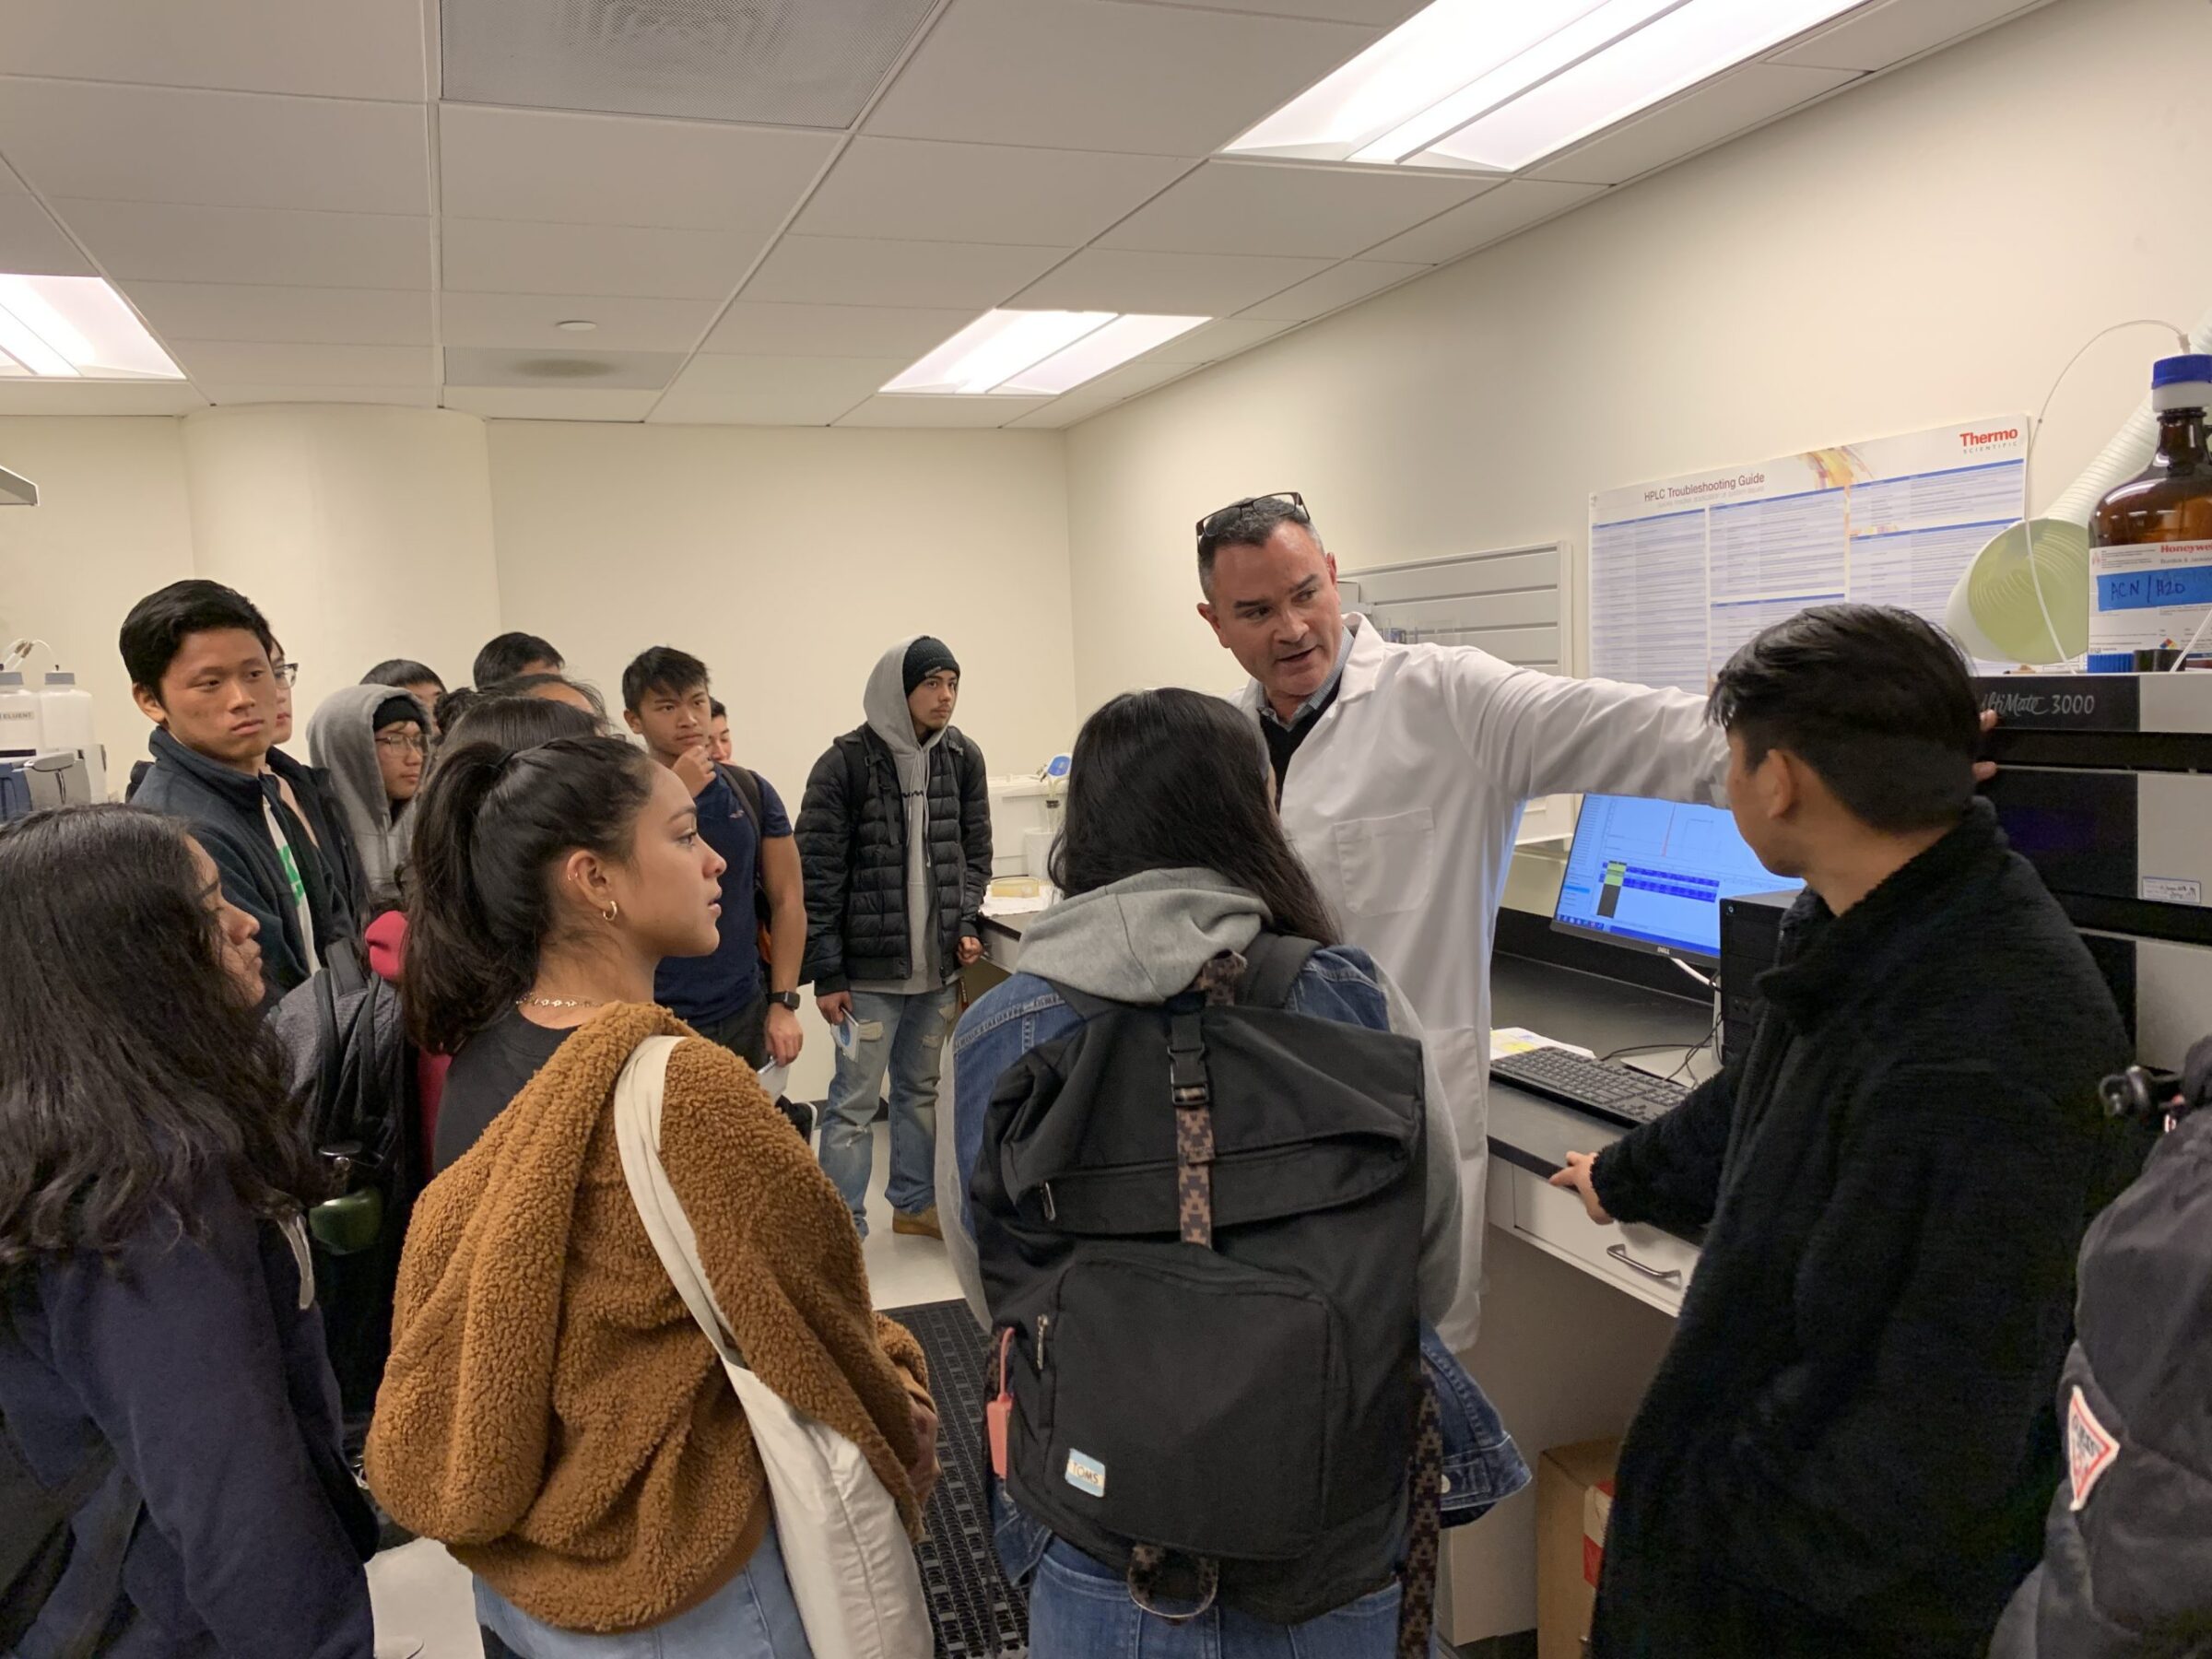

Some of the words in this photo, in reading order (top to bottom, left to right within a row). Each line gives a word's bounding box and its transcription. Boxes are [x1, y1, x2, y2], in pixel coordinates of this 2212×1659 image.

[1959, 429, 2018, 447] Thermo
[1963, 441, 2018, 454] SCIENTIFIC
[1644, 488, 1665, 502] HPLC
[1667, 478, 1736, 498] Troubleshooting
[1738, 473, 1765, 486] Guide
[2160, 544, 2212, 553] Honeywe
[2051, 694, 2095, 714] 3000
[1073, 1461, 1099, 1484] TOMS
